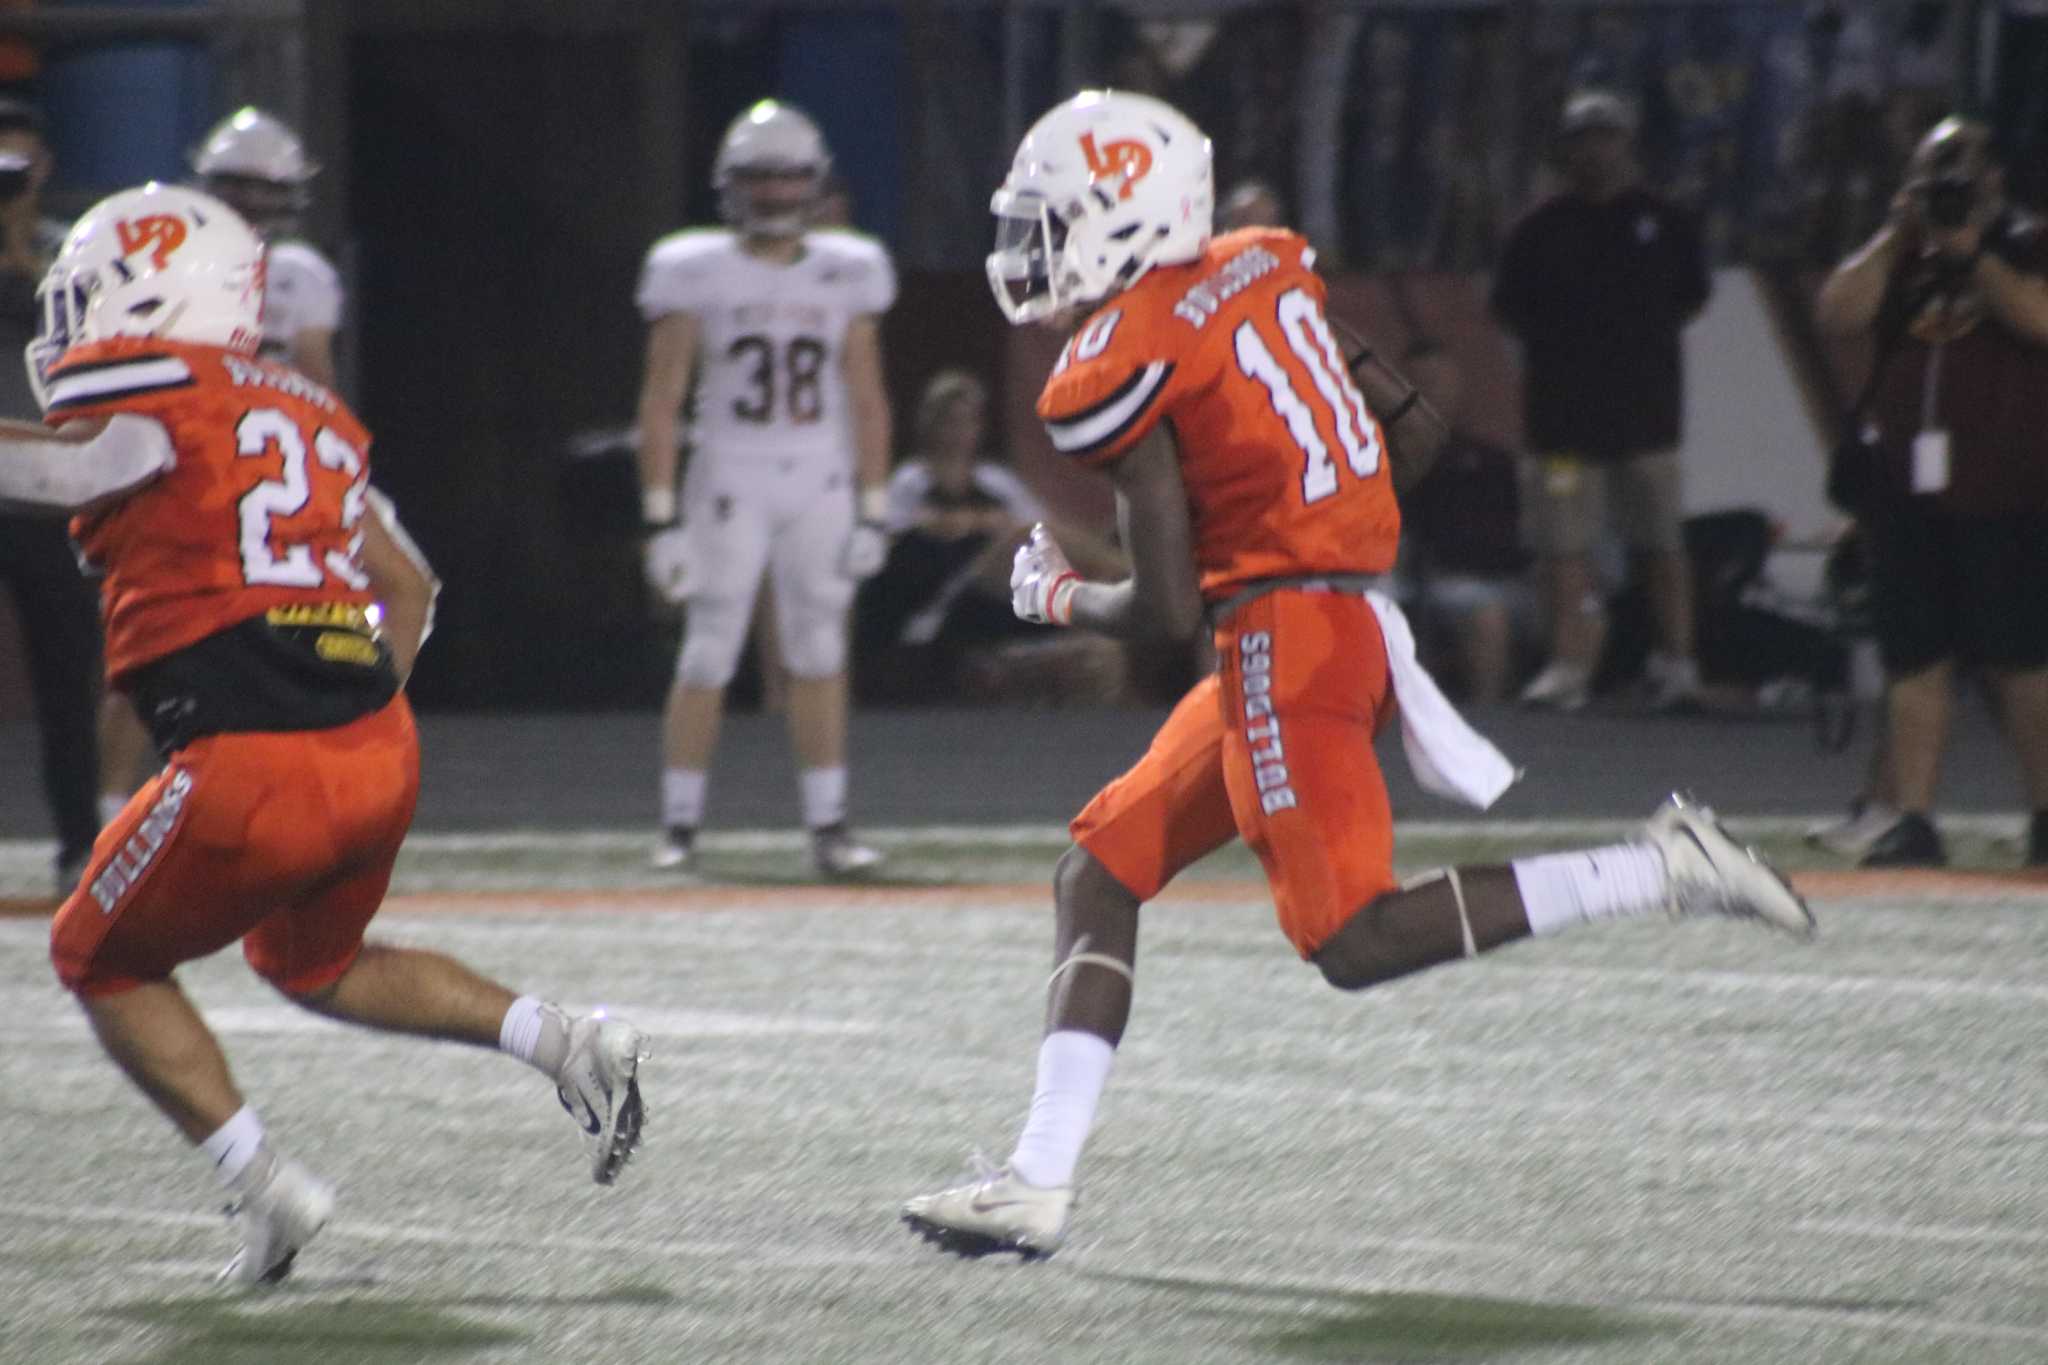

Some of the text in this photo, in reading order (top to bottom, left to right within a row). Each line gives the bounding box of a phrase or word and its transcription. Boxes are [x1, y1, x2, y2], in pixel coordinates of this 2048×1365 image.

[727, 335, 827, 426] 38
[1234, 288, 1380, 504] 10
[236, 409, 371, 586] 23
[1241, 630, 1296, 815] BULLDOGS
[90, 768, 192, 913] BULLDOGS
